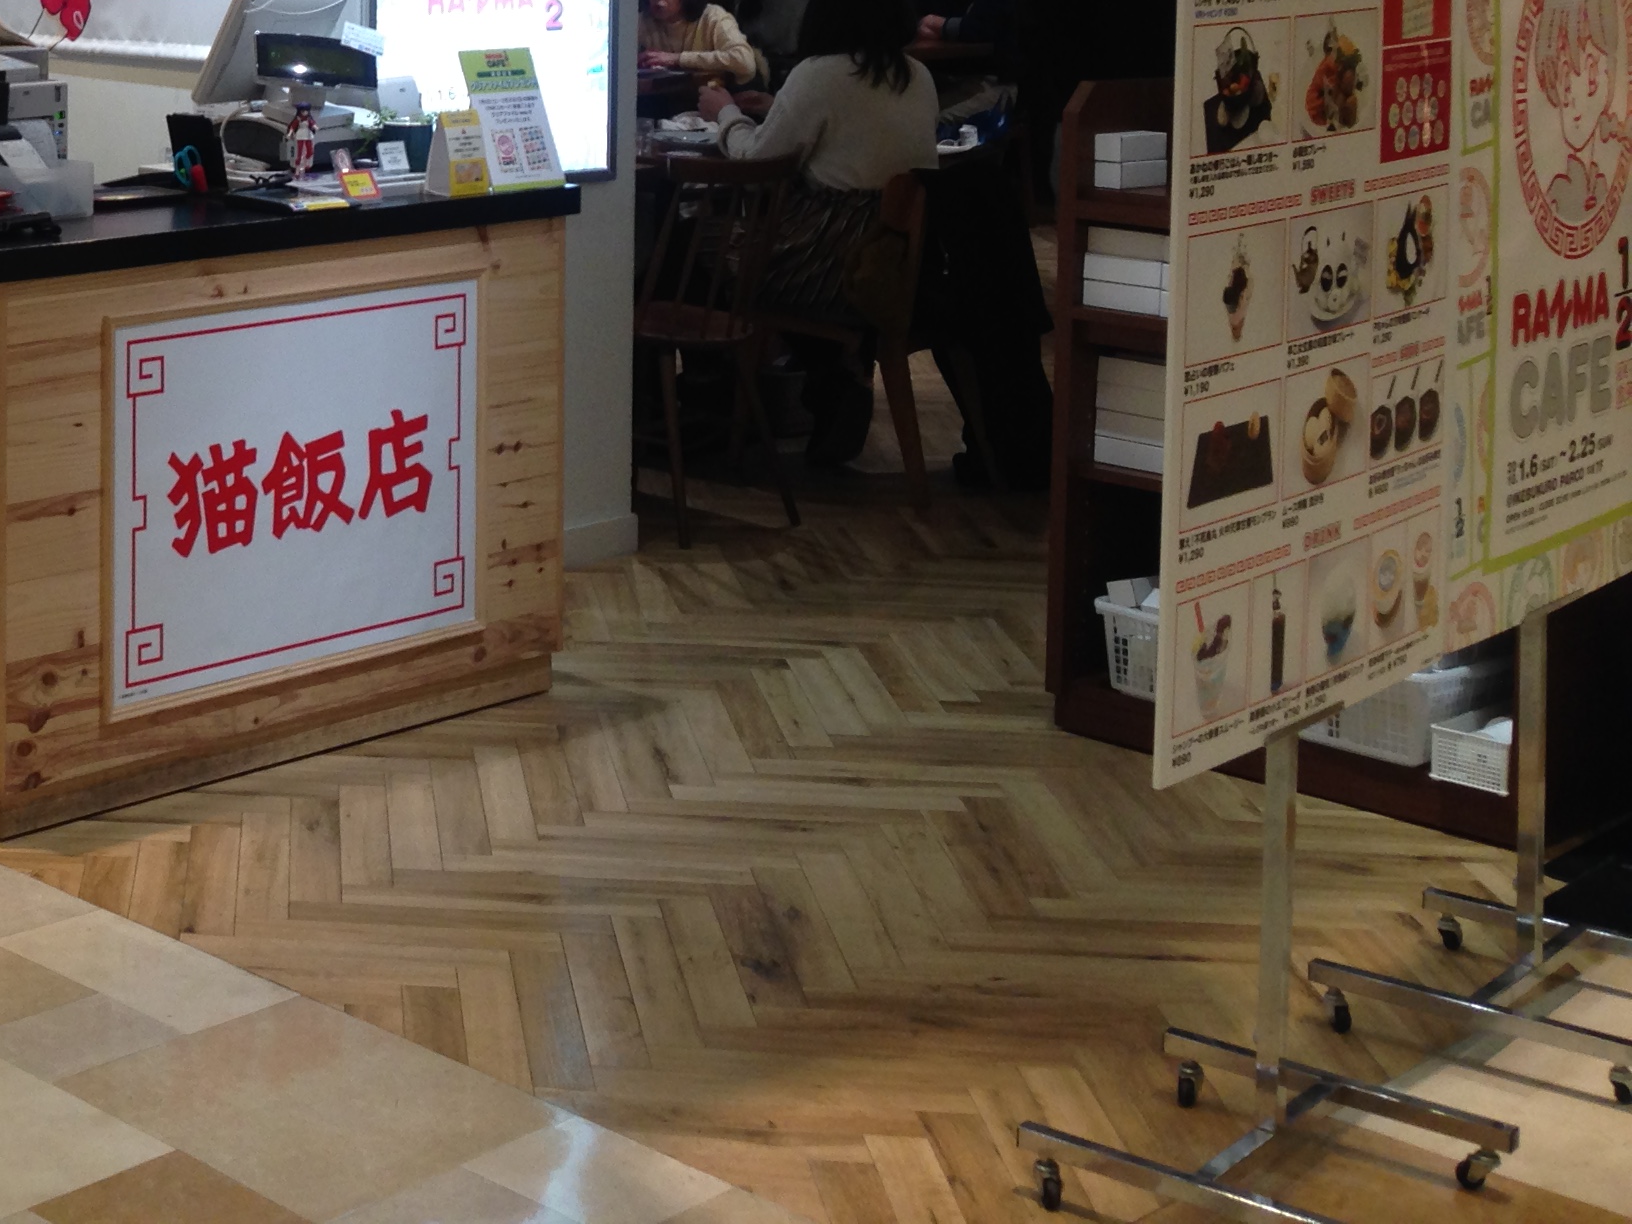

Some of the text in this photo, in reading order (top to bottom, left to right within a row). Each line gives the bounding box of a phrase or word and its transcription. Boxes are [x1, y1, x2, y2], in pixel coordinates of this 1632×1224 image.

[1310, 179, 1356, 206] SWEETS
[1510, 335, 1612, 438] CAFE
[1569, 432, 1596, 463] 2.25
[166, 408, 435, 559] 猫飯店
[1303, 521, 1342, 551] DRINK
